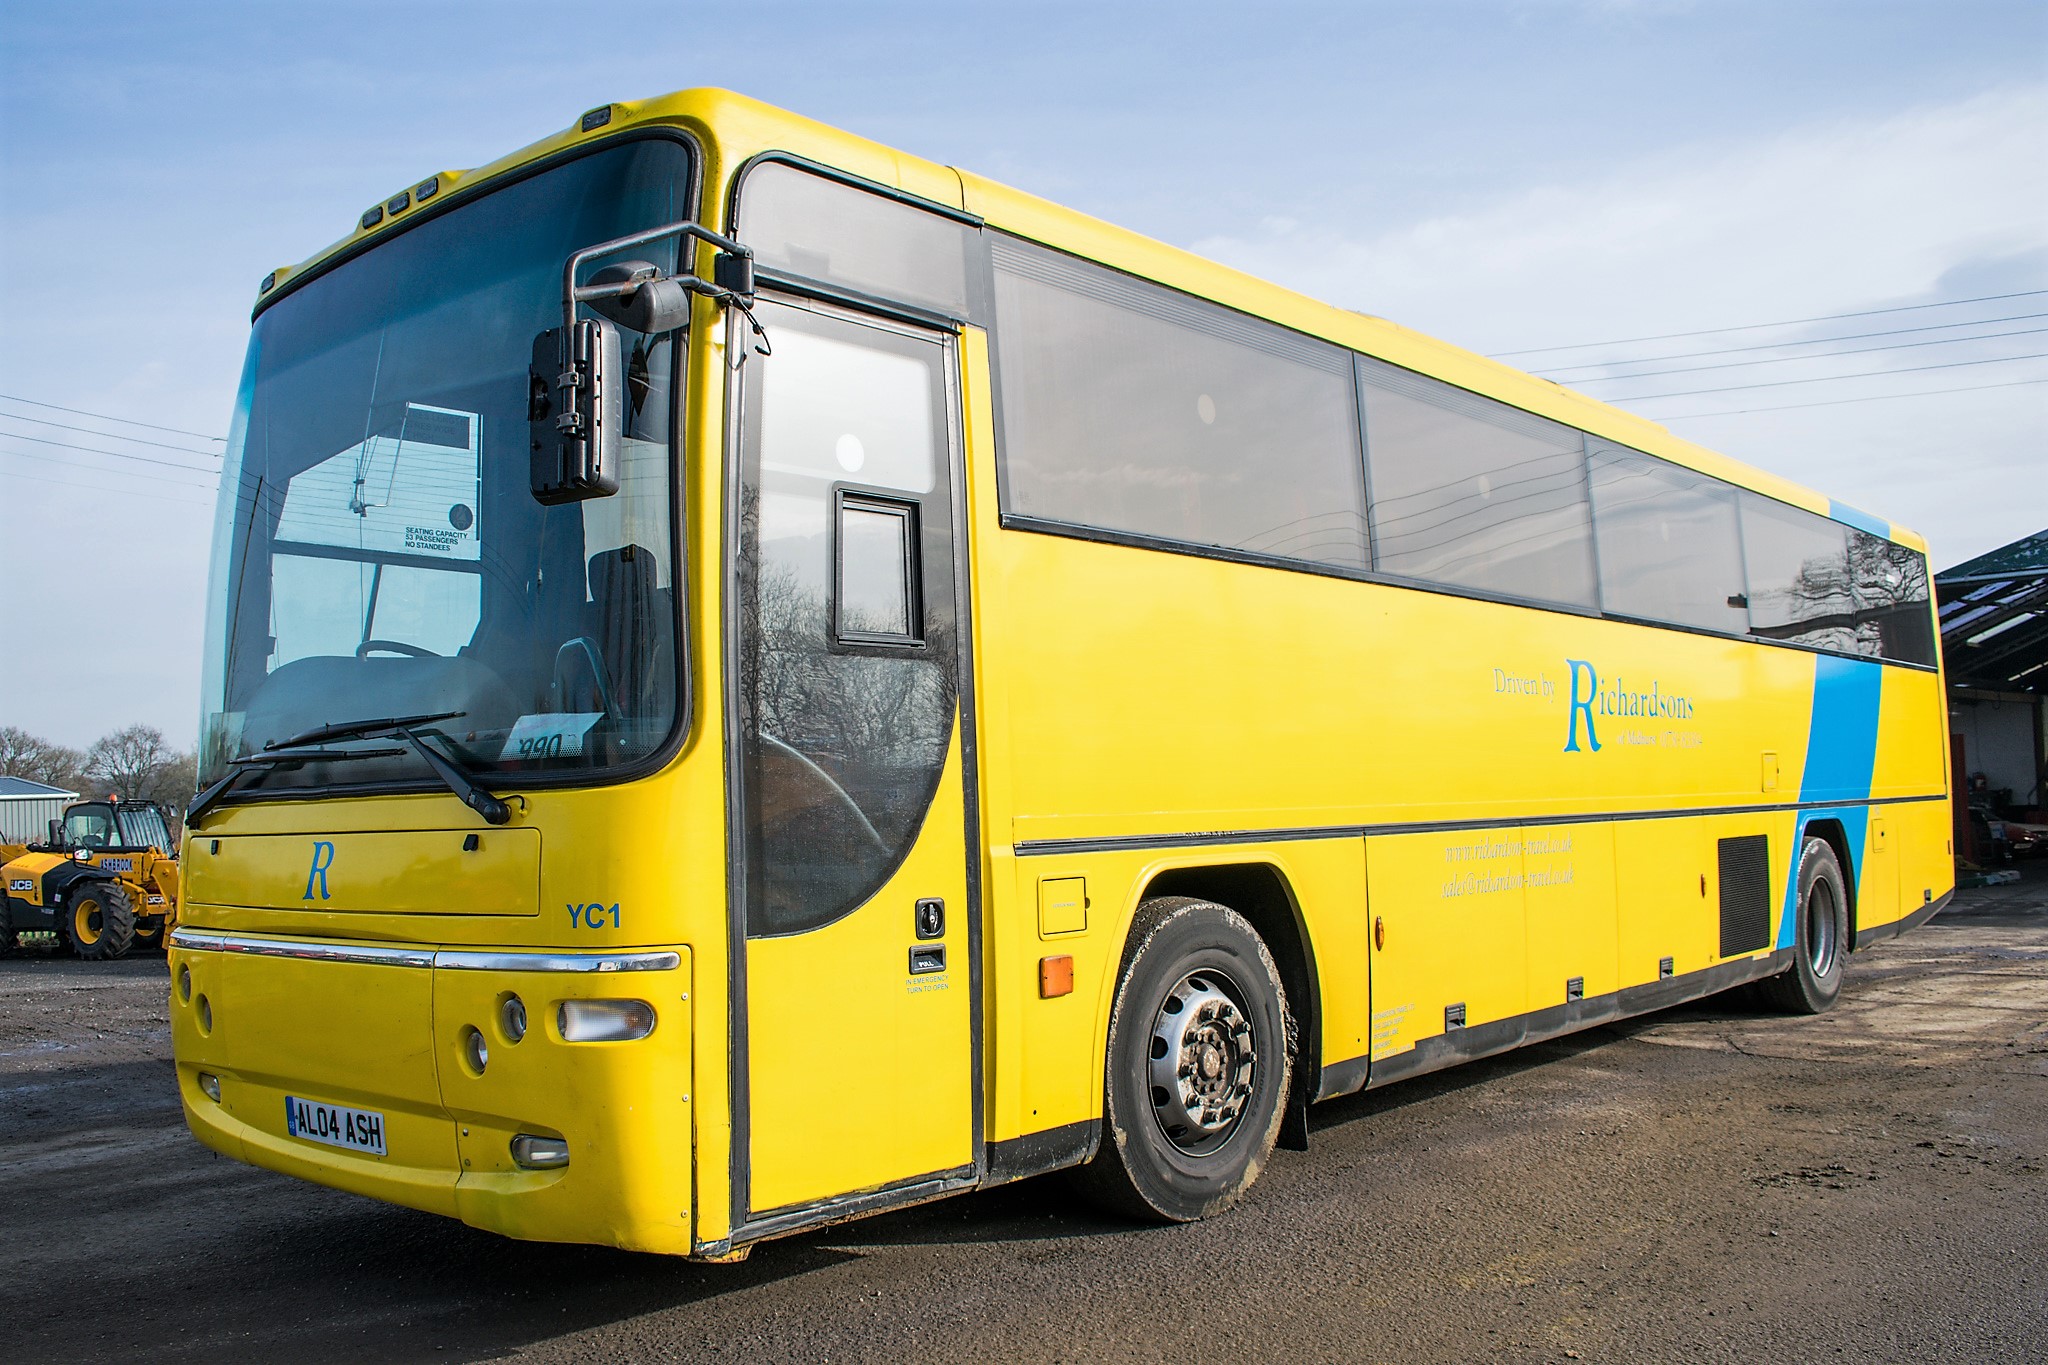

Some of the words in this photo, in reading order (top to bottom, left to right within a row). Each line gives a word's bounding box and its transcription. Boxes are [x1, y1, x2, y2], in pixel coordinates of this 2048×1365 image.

[405, 526, 433, 536] SEATING
[435, 530, 468, 539] CAPACITY
[415, 534, 458, 545] PASSENGERS
[416, 542, 451, 551] STANDEES
[1493, 668, 1538, 695] Driven
[1541, 673, 1555, 703] by
[1563, 658, 1693, 752] Richardsons
[302, 840, 335, 900] R
[10, 880, 33, 890] JCB
[566, 903, 620, 929] YC1
[913, 974, 949, 985] EMERGENCY
[907, 986, 922, 994] TURN
[933, 983, 949, 991] OPEN
[299, 1103, 340, 1140] AL04
[346, 1112, 382, 1148] ASH
